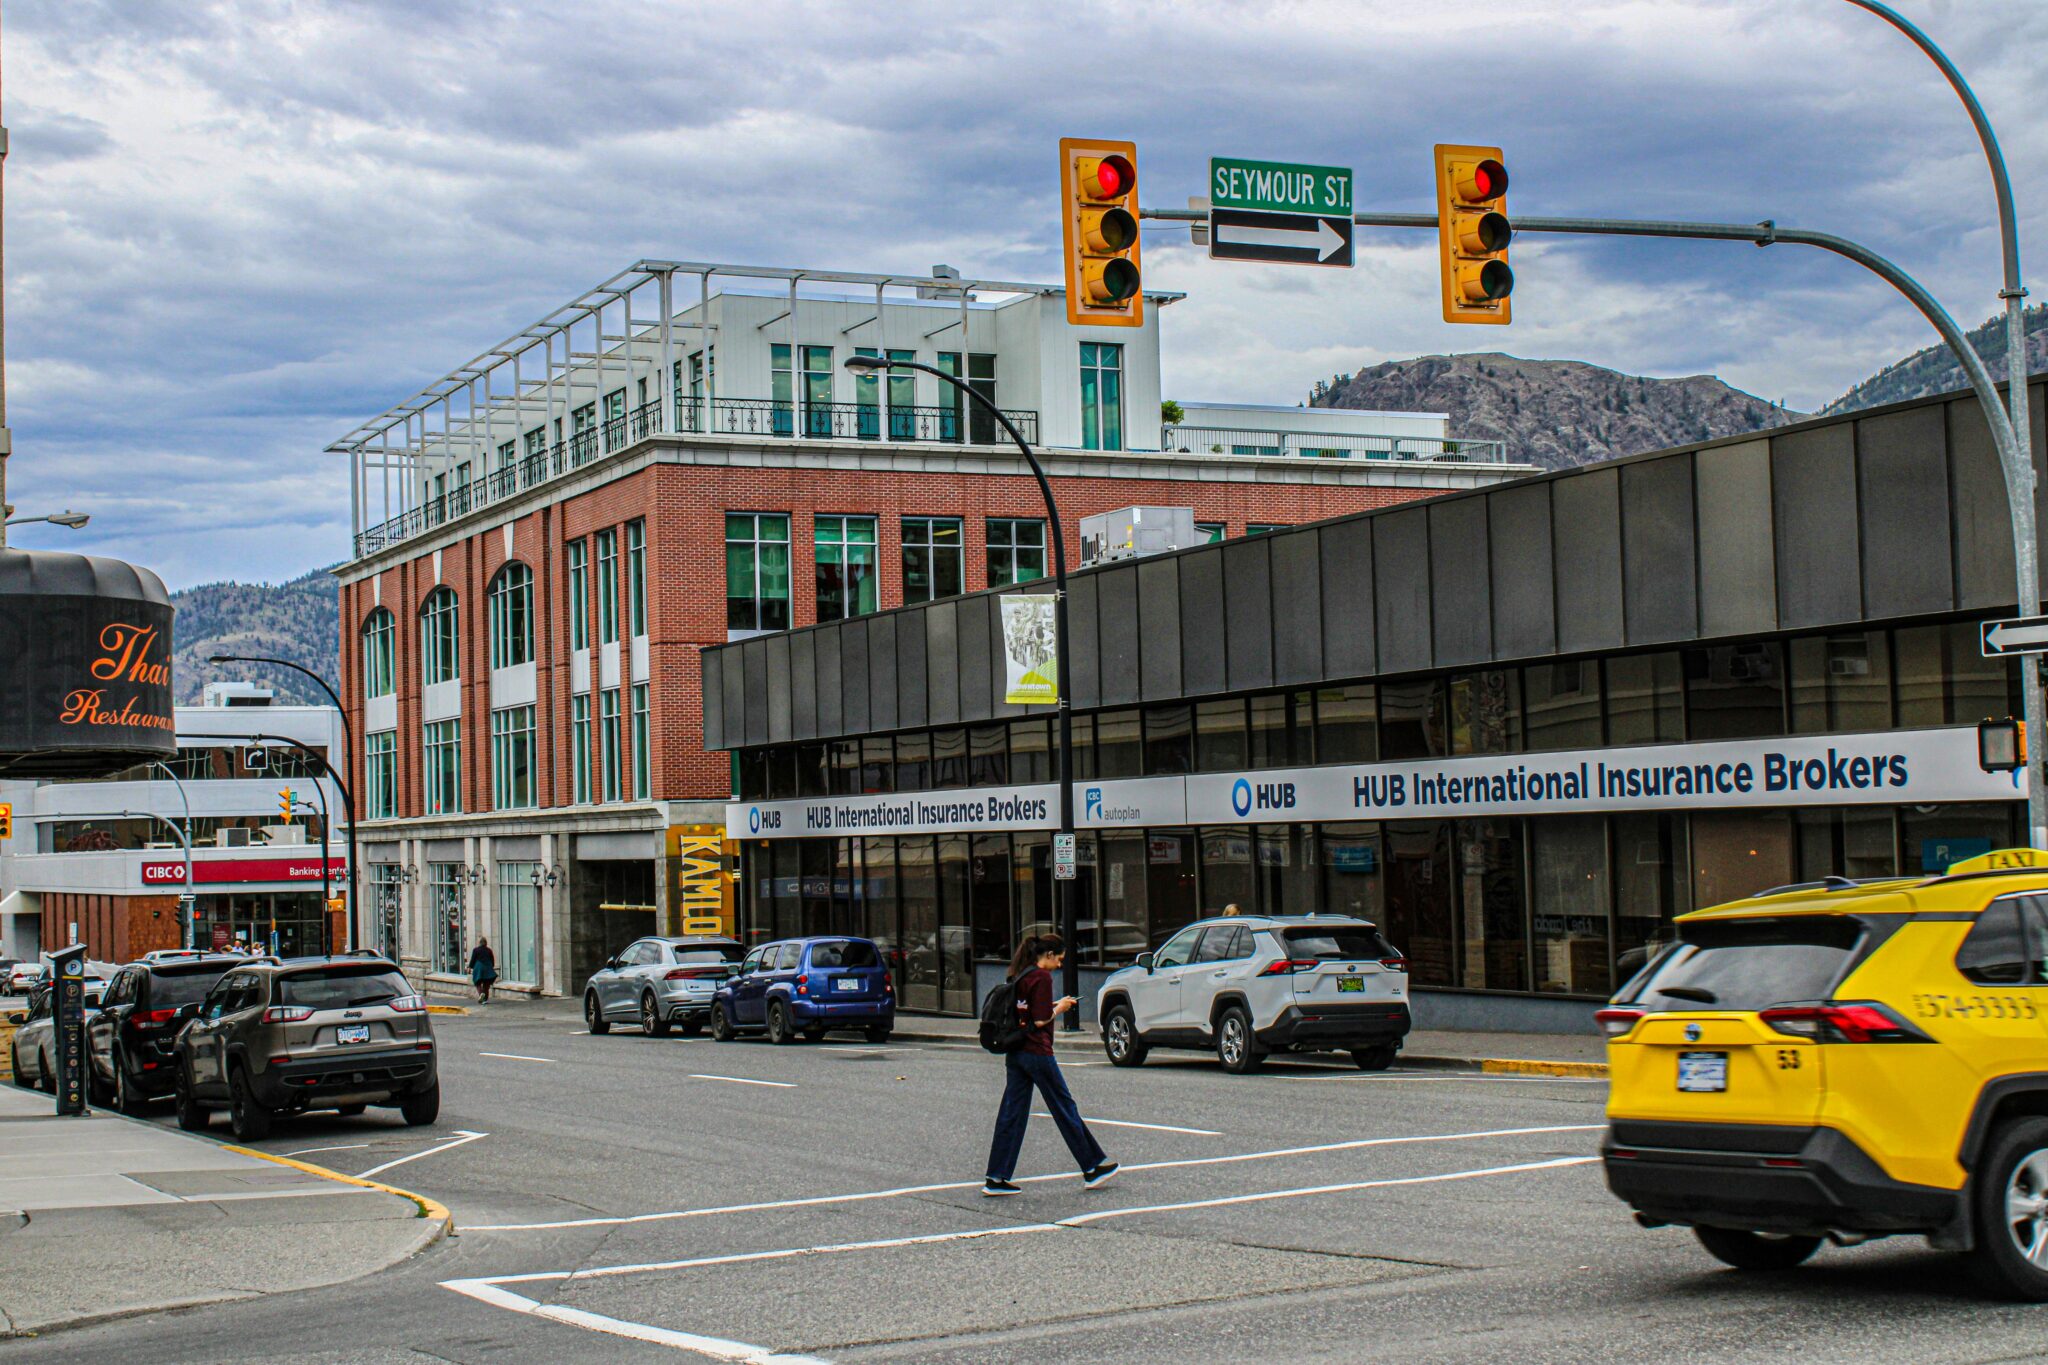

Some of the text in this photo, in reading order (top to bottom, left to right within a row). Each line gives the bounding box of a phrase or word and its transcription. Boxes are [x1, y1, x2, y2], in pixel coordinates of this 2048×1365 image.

[1215, 166, 1350, 207] SEYMOUR ST.
[90, 623, 170, 686] Thai
[59, 689, 175, 731] Restauran
[1354, 748, 1908, 808] HUB International Insurance Brokers
[1088, 791, 1100, 800] ICBC
[1256, 782, 1296, 809] HUB
[762, 811, 781, 828] HUB
[807, 794, 1047, 829] HUB International Insurance Brokers
[1104, 805, 1141, 822] autoplan
[289, 866, 320, 877] Banking
[1986, 851, 2034, 869] TAXI
[145, 866, 173, 878] CIBC
[681, 835, 722, 935] KAMLO
[1777, 1049, 1800, 1069] 53
